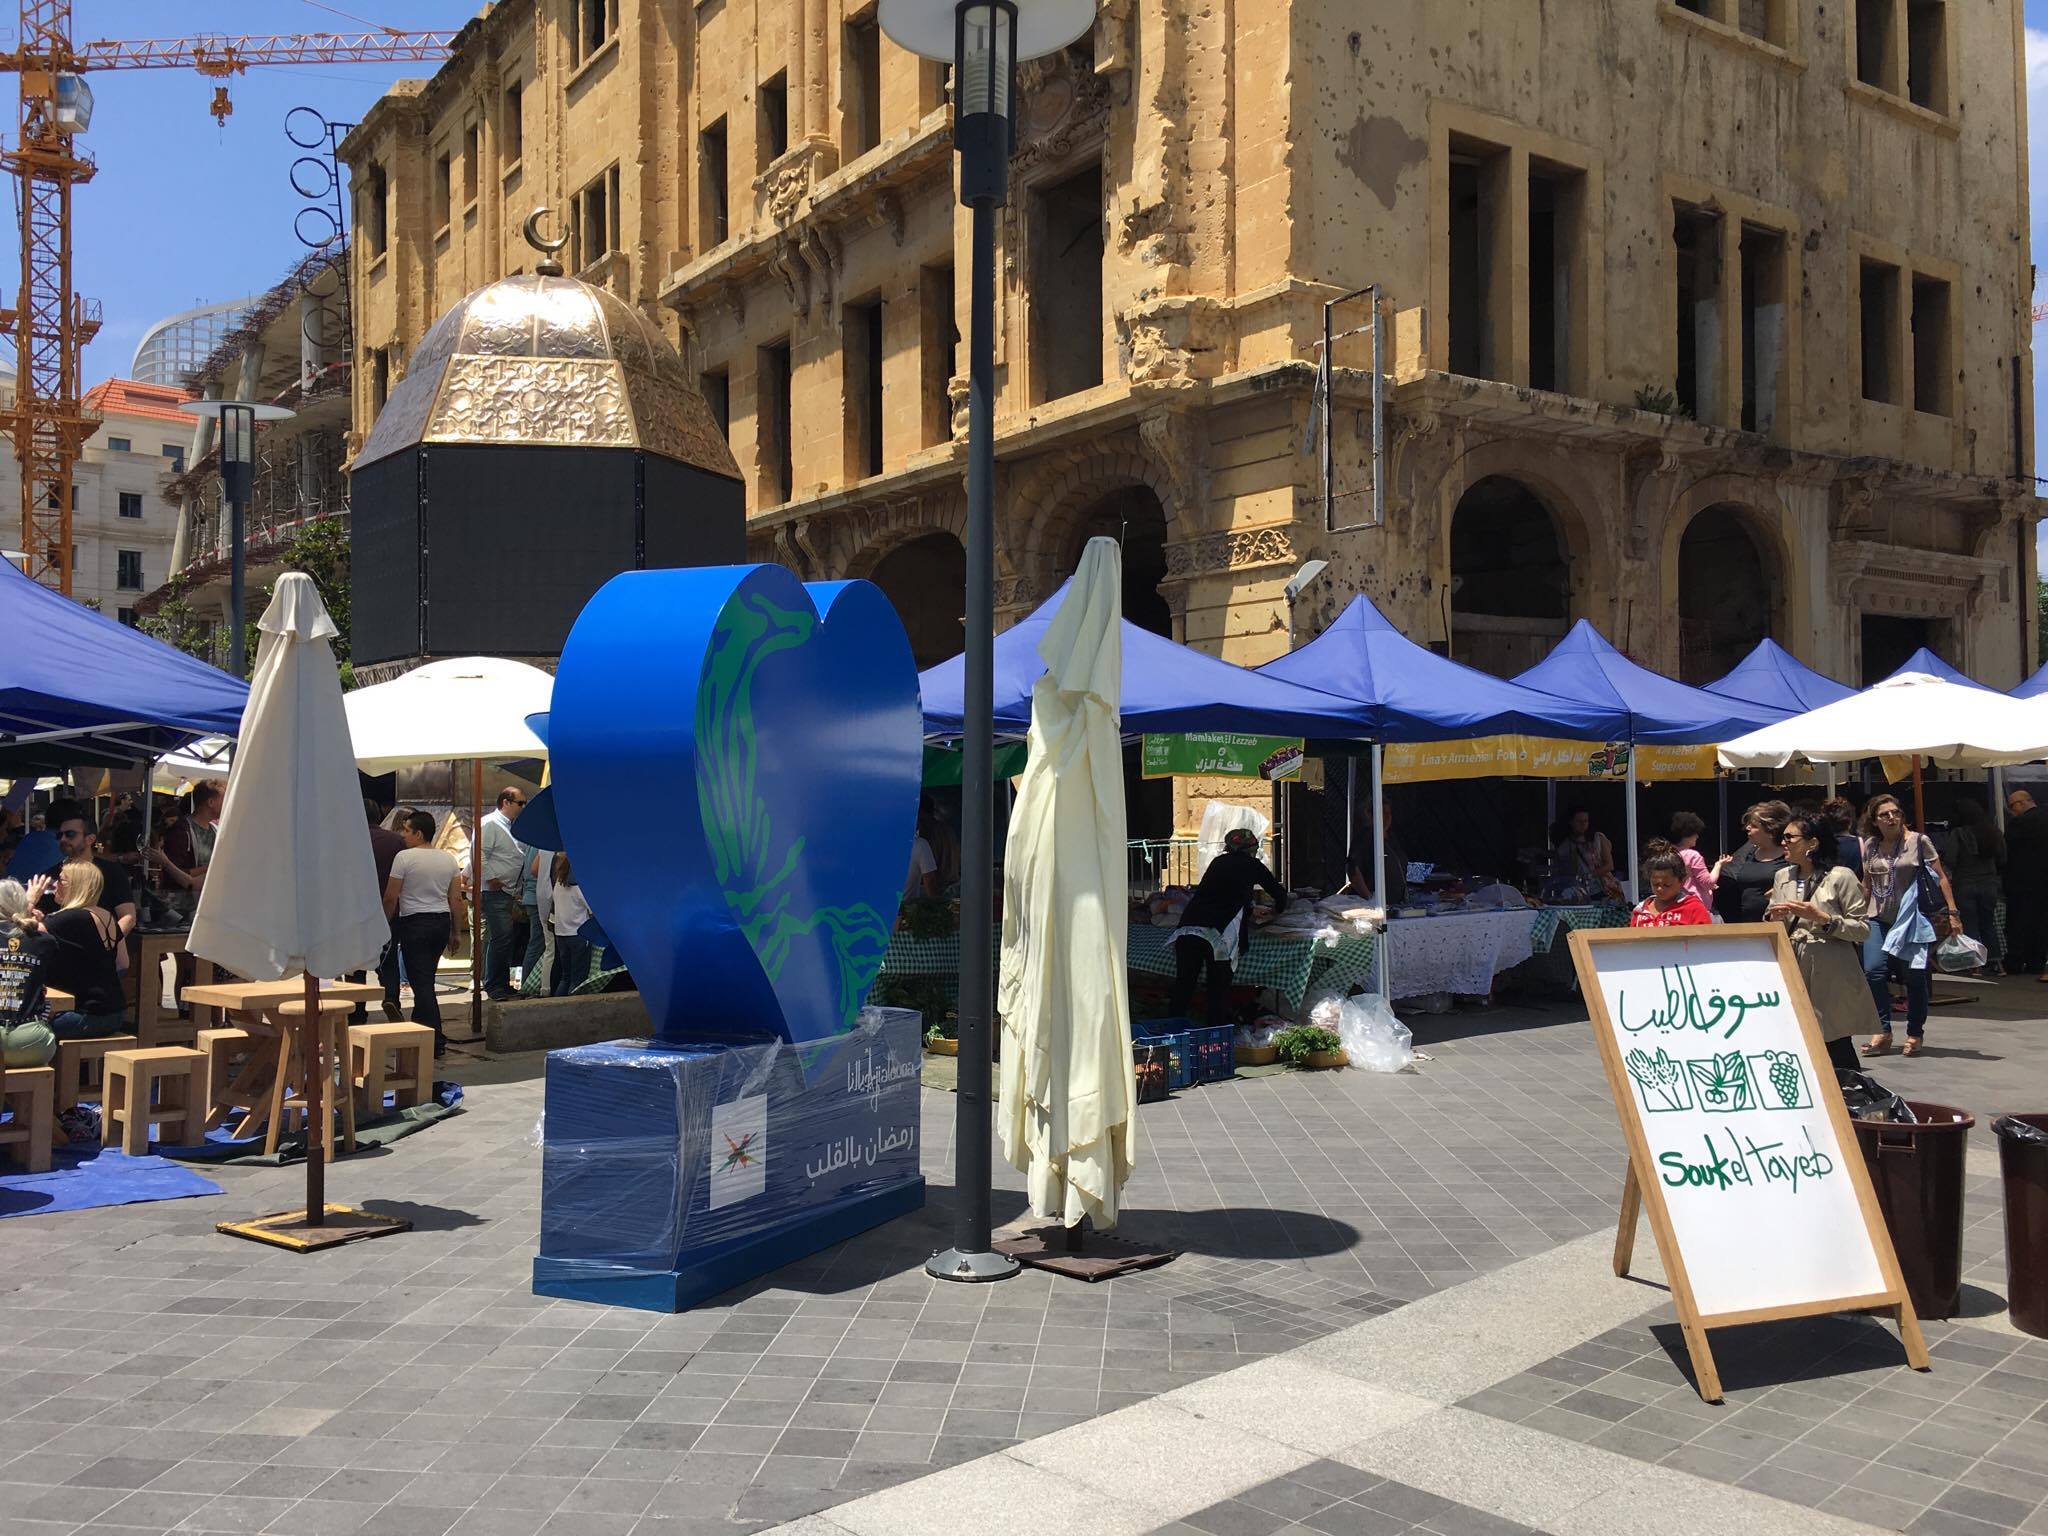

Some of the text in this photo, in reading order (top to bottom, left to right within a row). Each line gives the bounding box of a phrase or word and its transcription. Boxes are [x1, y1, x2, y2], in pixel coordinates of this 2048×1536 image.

[0, 954, 41, 966] UCTEES
[806, 1126, 914, 1188] رمضان بالقلب
[1658, 1133, 1733, 1191] Souk
